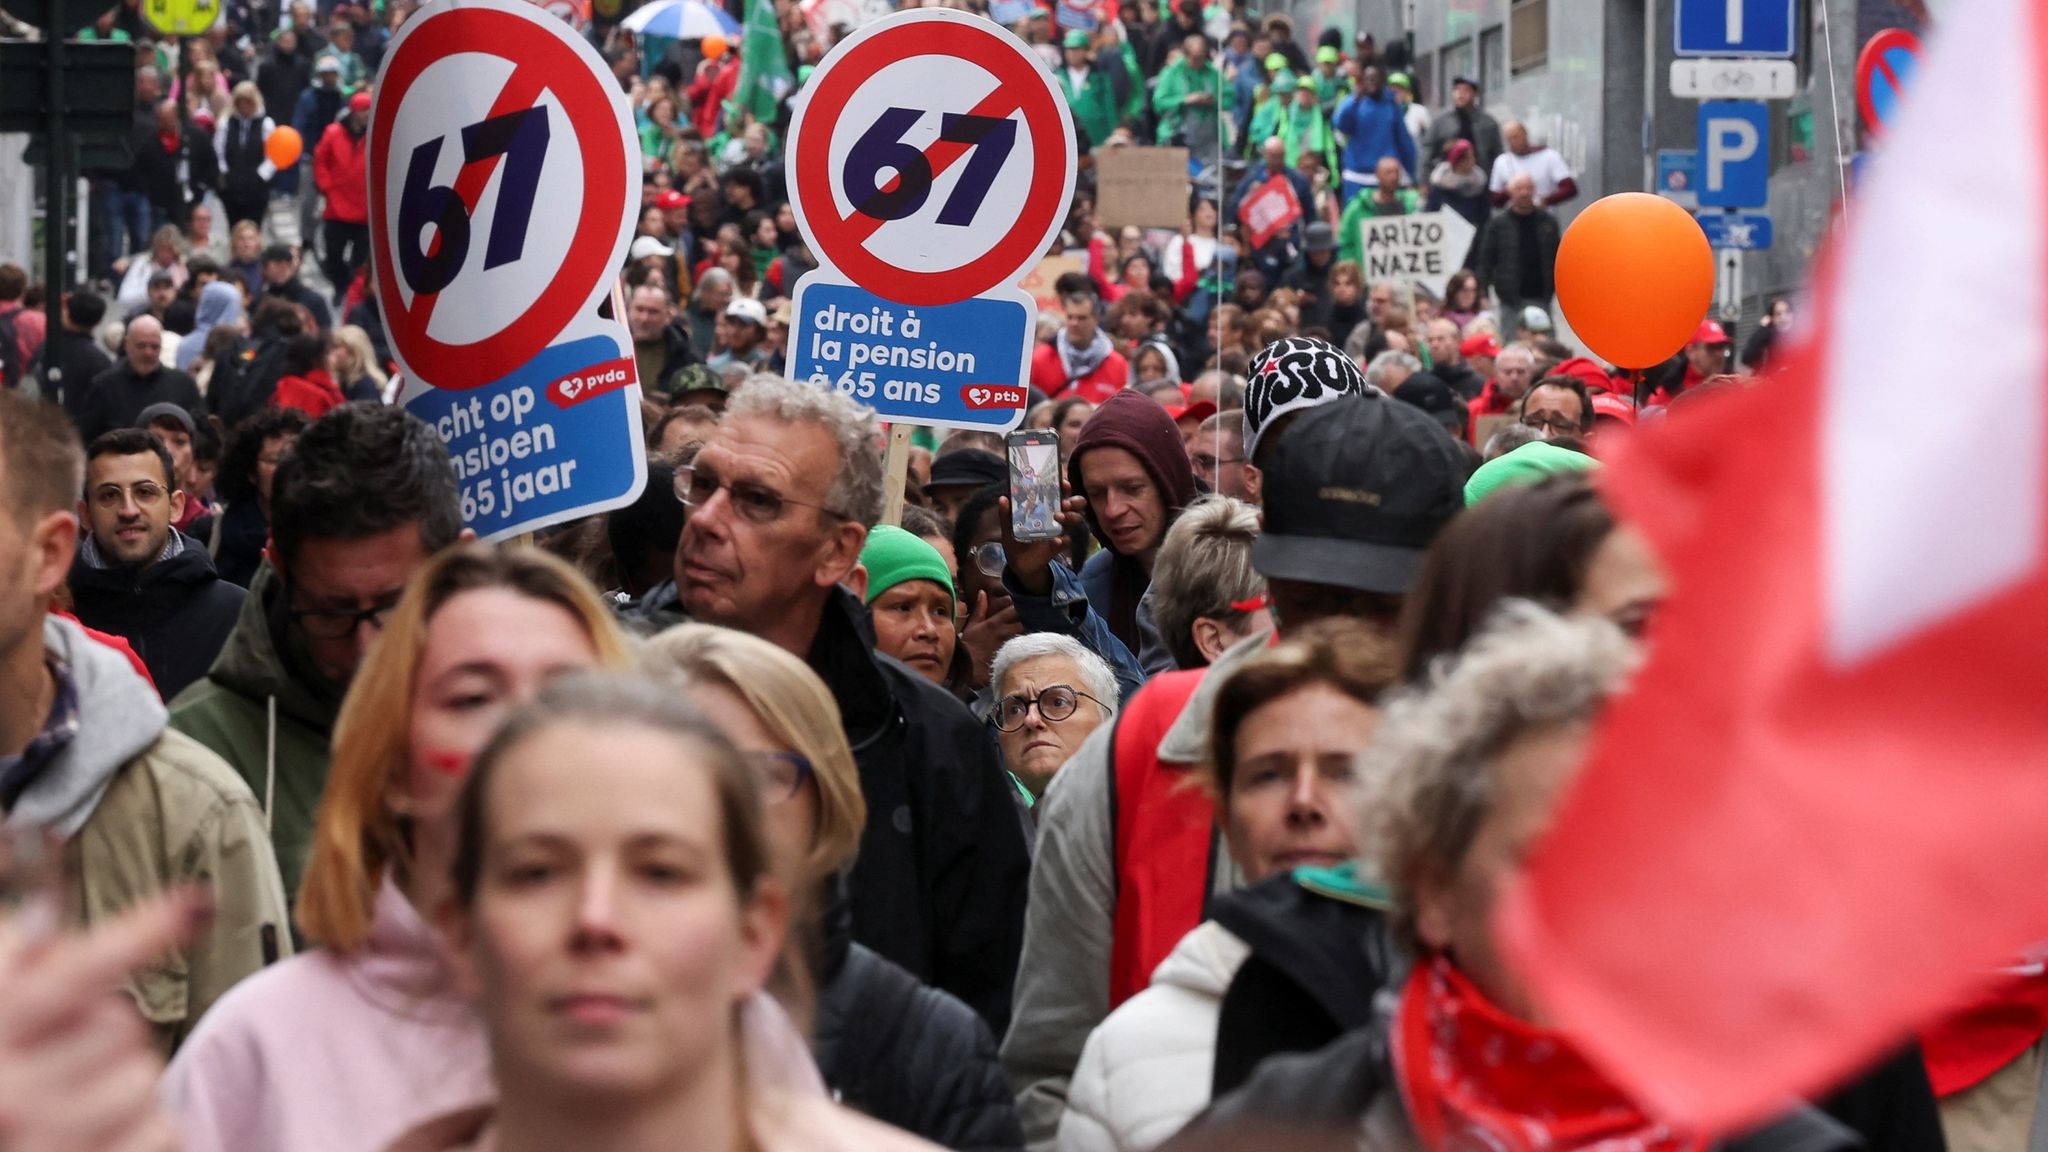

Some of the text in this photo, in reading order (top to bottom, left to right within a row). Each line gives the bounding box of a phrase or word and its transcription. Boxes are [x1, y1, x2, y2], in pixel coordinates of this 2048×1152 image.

[843, 107, 1017, 226] 67
[1706, 118, 1759, 192] P
[398, 105, 550, 294] 67
[1370, 251, 1441, 277] NAZE
[814, 304, 921, 338] droit à
[811, 333, 975, 373] la pension
[587, 370, 626, 390] pvda
[808, 365, 941, 404] à 65 ans
[993, 391, 1020, 404] ptb
[437, 385, 535, 443] cht op
[448, 423, 556, 480] nsioen
[460, 458, 577, 522] 65 jaar
